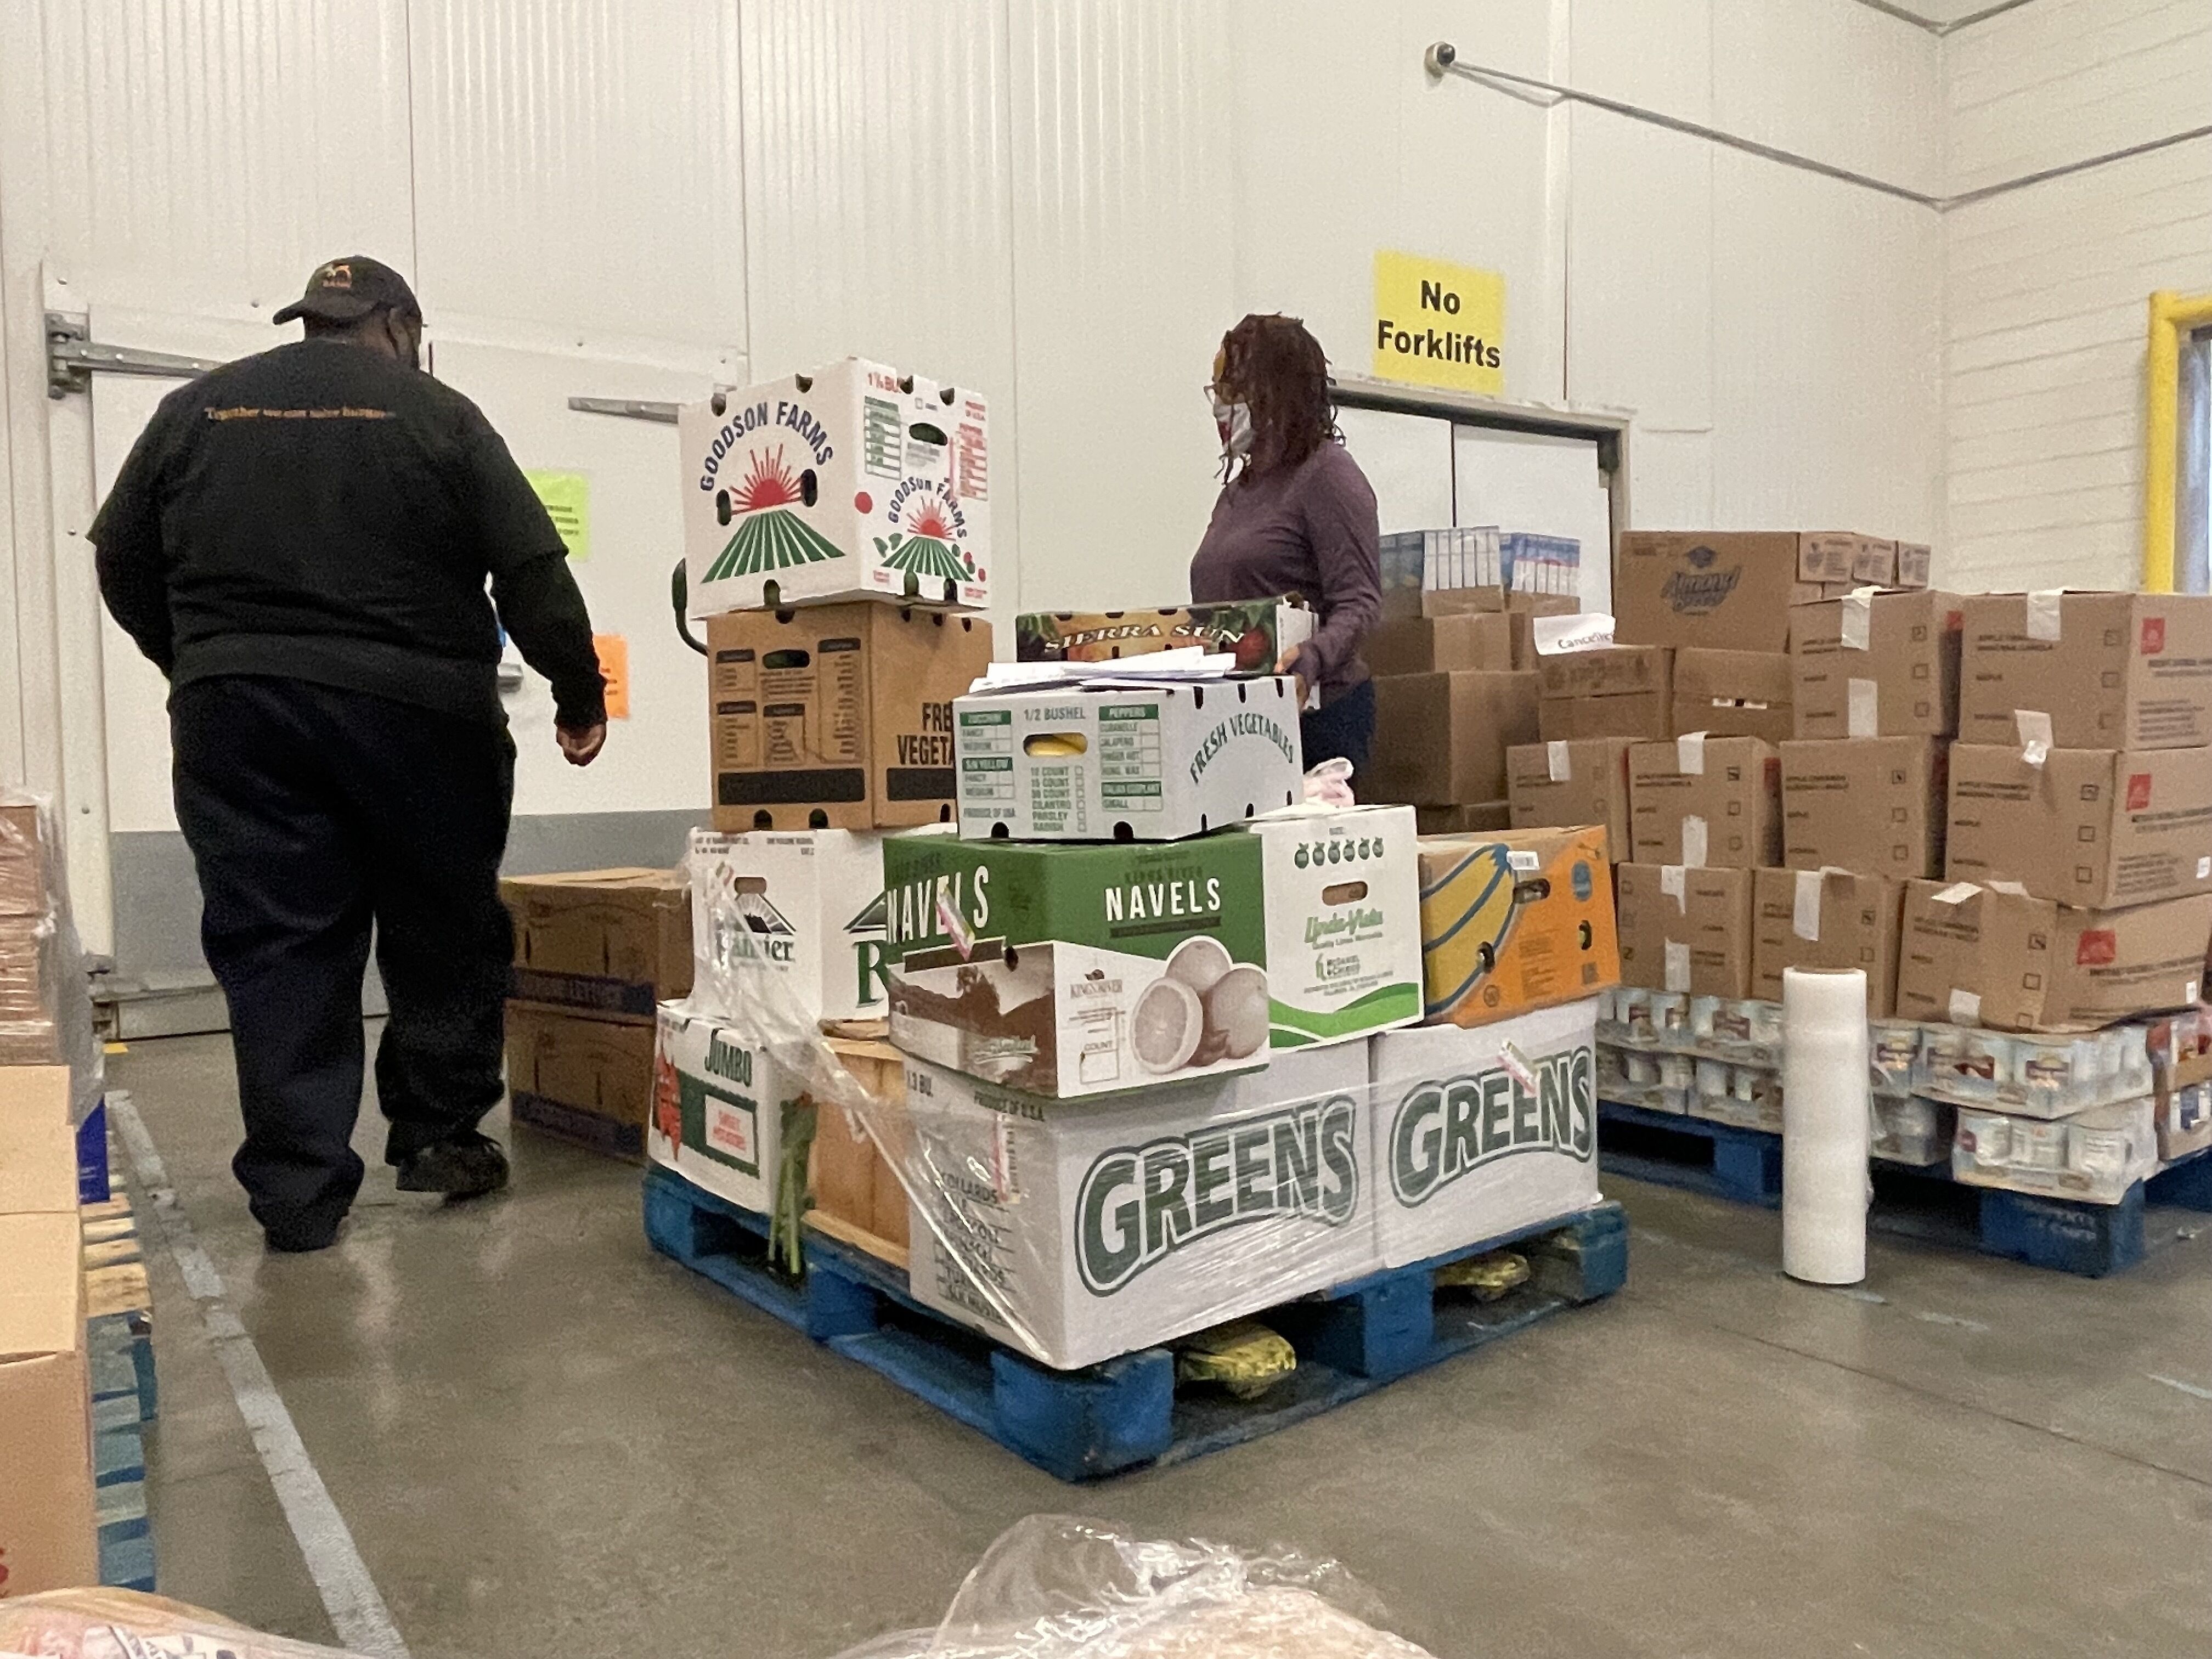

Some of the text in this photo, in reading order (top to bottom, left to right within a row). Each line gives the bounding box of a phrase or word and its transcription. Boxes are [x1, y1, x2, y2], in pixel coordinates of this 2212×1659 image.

[1421, 280, 1460, 314] No
[1378, 319, 1500, 368] Forklifts
[700, 402, 768, 491] GOODSON
[776, 400, 833, 465] FARMS
[1043, 623, 1245, 653] SIERRA SUN
[922, 702, 953, 732] FRE
[1024, 706, 1086, 722] 1/2 BUSHEL
[1189, 712, 1294, 784] FRESH VEGETABLES
[887, 866, 989, 945] NAVELS
[1105, 878, 1220, 922] NAVELS
[705, 1040, 752, 1087] JUMBO
[1389, 1045, 1592, 1208] GREENS
[1074, 1094, 1359, 1296] GREENS
